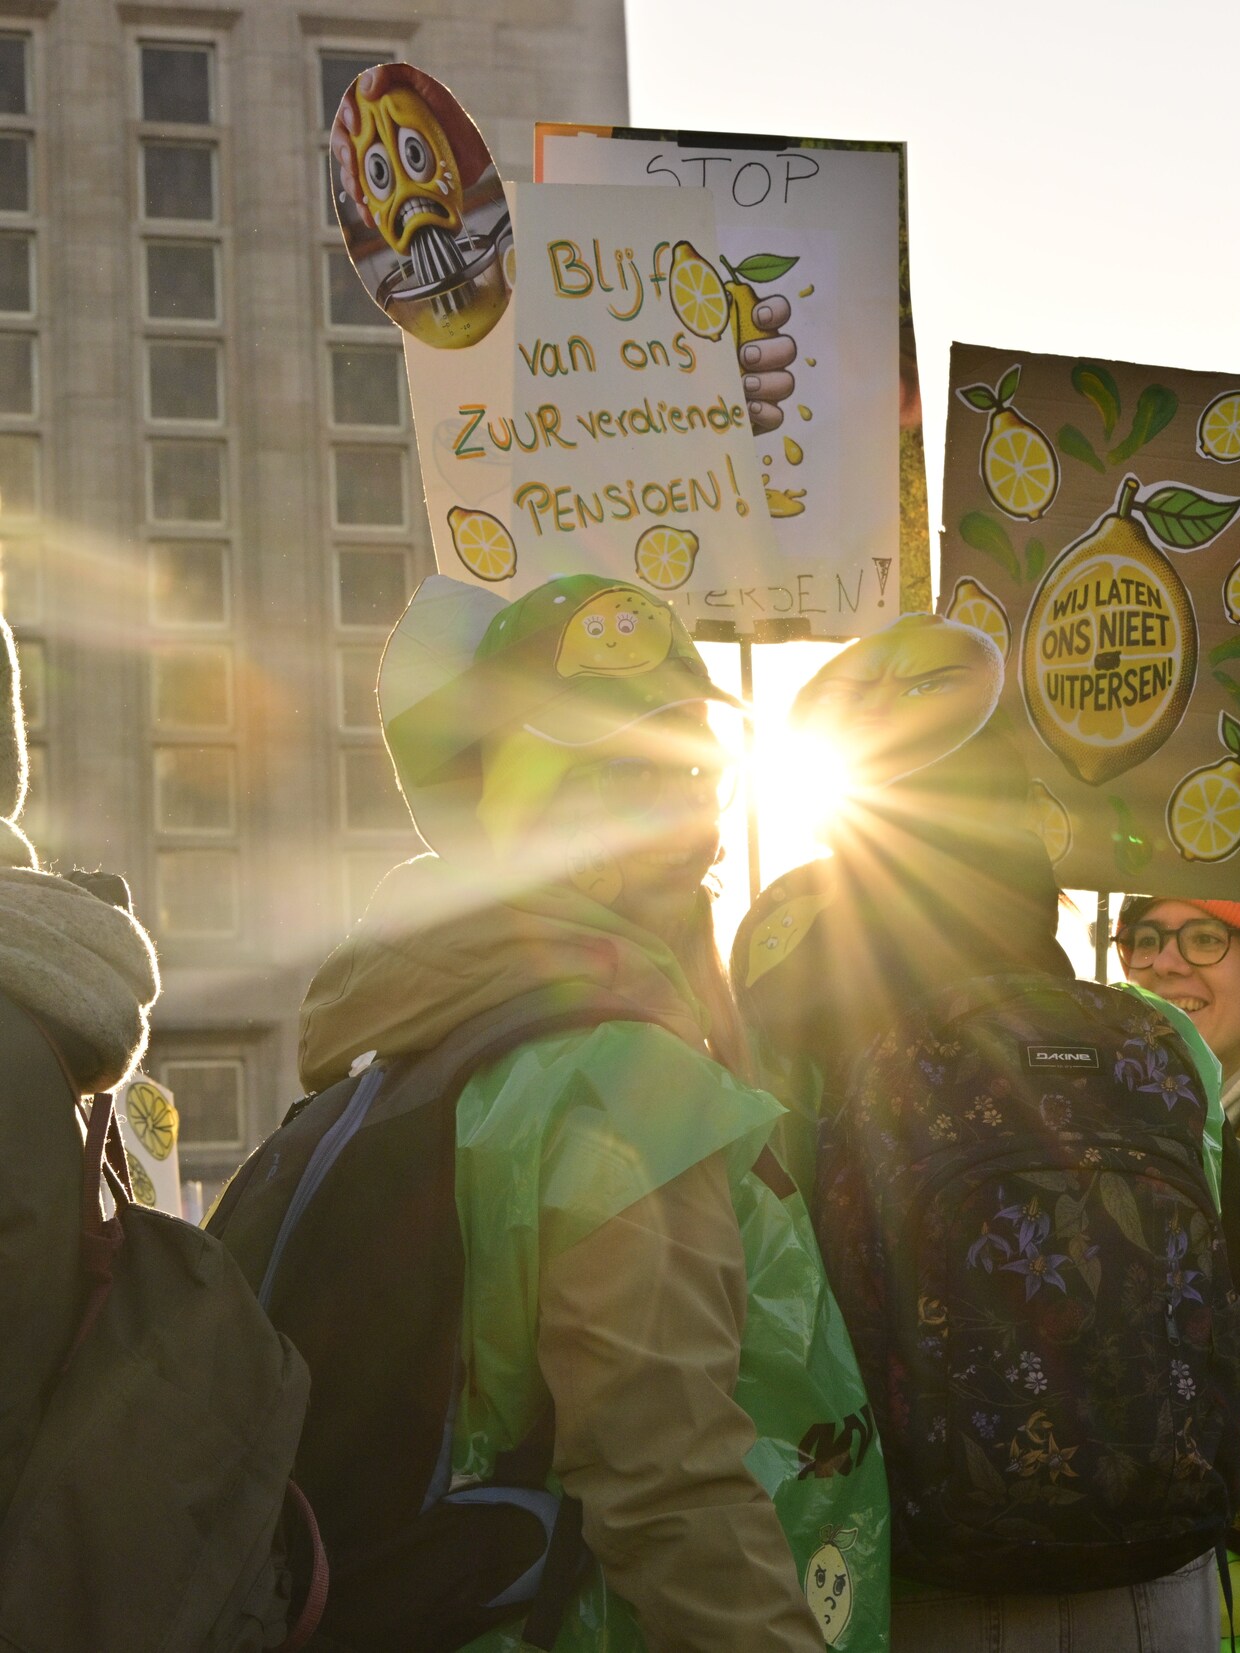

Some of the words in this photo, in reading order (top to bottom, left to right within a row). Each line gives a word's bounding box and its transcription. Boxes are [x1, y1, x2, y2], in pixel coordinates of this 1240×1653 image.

[646, 154, 820, 207] STOP
[547, 238, 670, 321] Blijf
[519, 335, 596, 377] van
[620, 332, 697, 374] ons
[452, 404, 577, 460] ZUUR
[576, 395, 745, 441] verdiende
[1053, 583, 1089, 620] WIJ
[1095, 578, 1162, 610] LATEN
[1042, 619, 1091, 660] ONS
[1100, 611, 1170, 649] NIEET
[1047, 657, 1173, 712] UITPERSEN!
[1036, 1052, 1092, 1061] DAKINE
